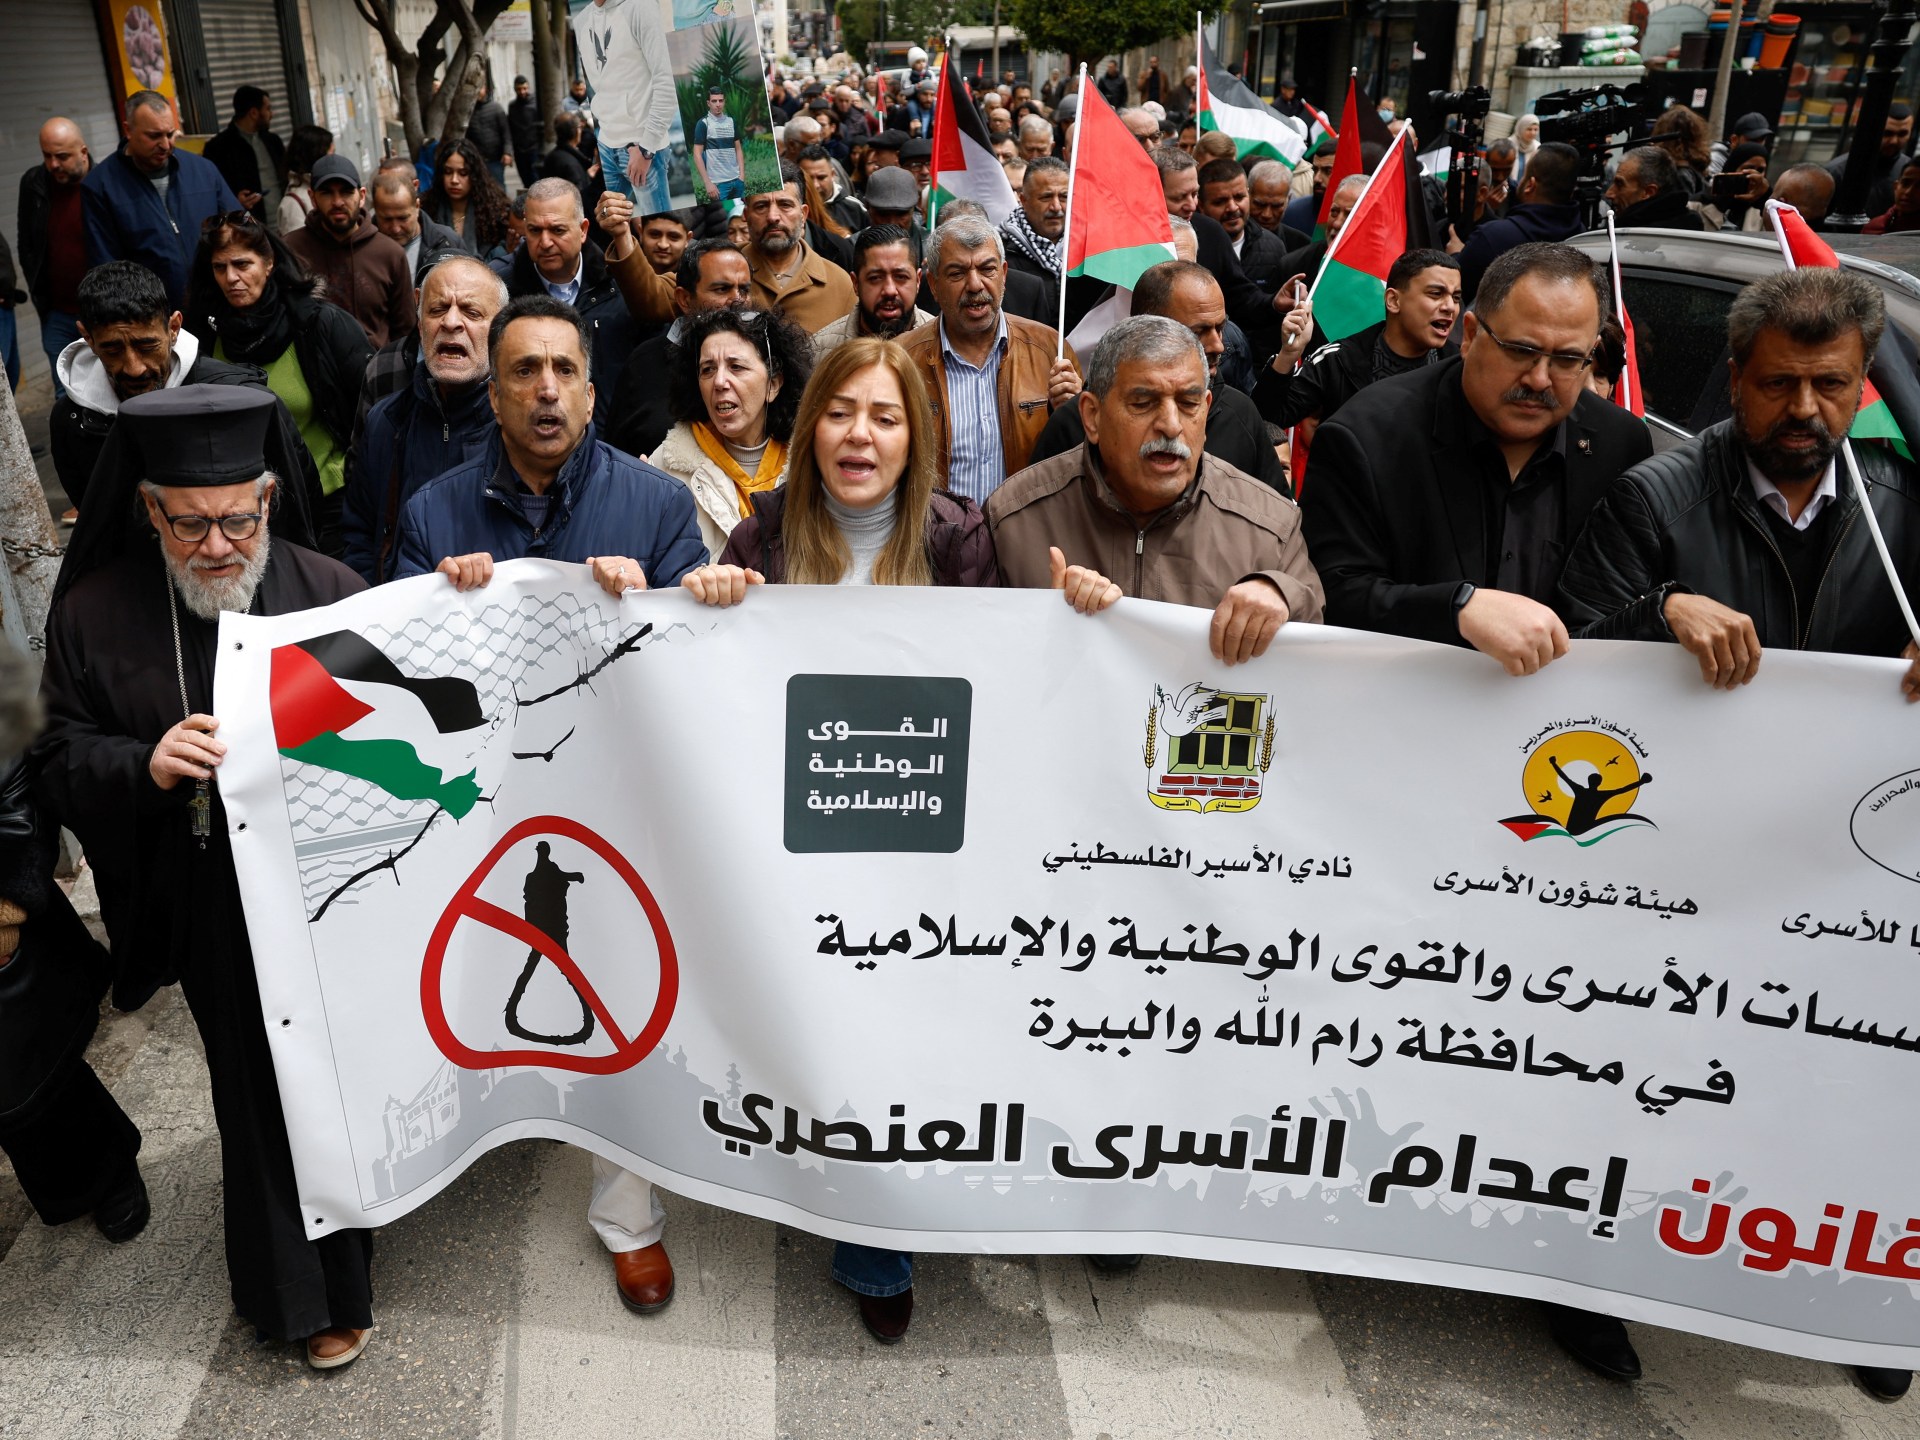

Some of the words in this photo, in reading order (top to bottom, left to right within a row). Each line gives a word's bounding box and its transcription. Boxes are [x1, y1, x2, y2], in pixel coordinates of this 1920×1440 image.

[808, 717, 947, 740] القوى
[1564, 715, 1602, 727] الأسرى
[1602, 720, 1631, 737] شؤون
[809, 753, 943, 778] الوطنية
[807, 790, 941, 815] والإسلامية
[1042, 842, 1191, 873] الفلسطيني
[1192, 845, 1282, 878] الأسير
[1289, 856, 1351, 883] نادي
[1433, 865, 1533, 895] الأسرى
[1539, 880, 1619, 909] شؤون
[1624, 886, 1699, 920] هيئة
[814, 913, 1096, 972] والإسلامية
[1781, 910, 1901, 944] للأسرى
[1107, 917, 1320, 981] الوطنية
[1331, 941, 1512, 1002] والقوى
[1522, 957, 1728, 1018] الأسرى
[1028, 998, 1202, 1058] والبيرة
[1312, 1018, 1384, 1067] رام
[1396, 1018, 1624, 1086] محافظة
[1635, 1059, 1736, 1116] في
[702, 1093, 1025, 1162] العنصري
[1052, 1105, 1346, 1180] الأسرى
[1368, 1134, 1628, 1239] إعدام
